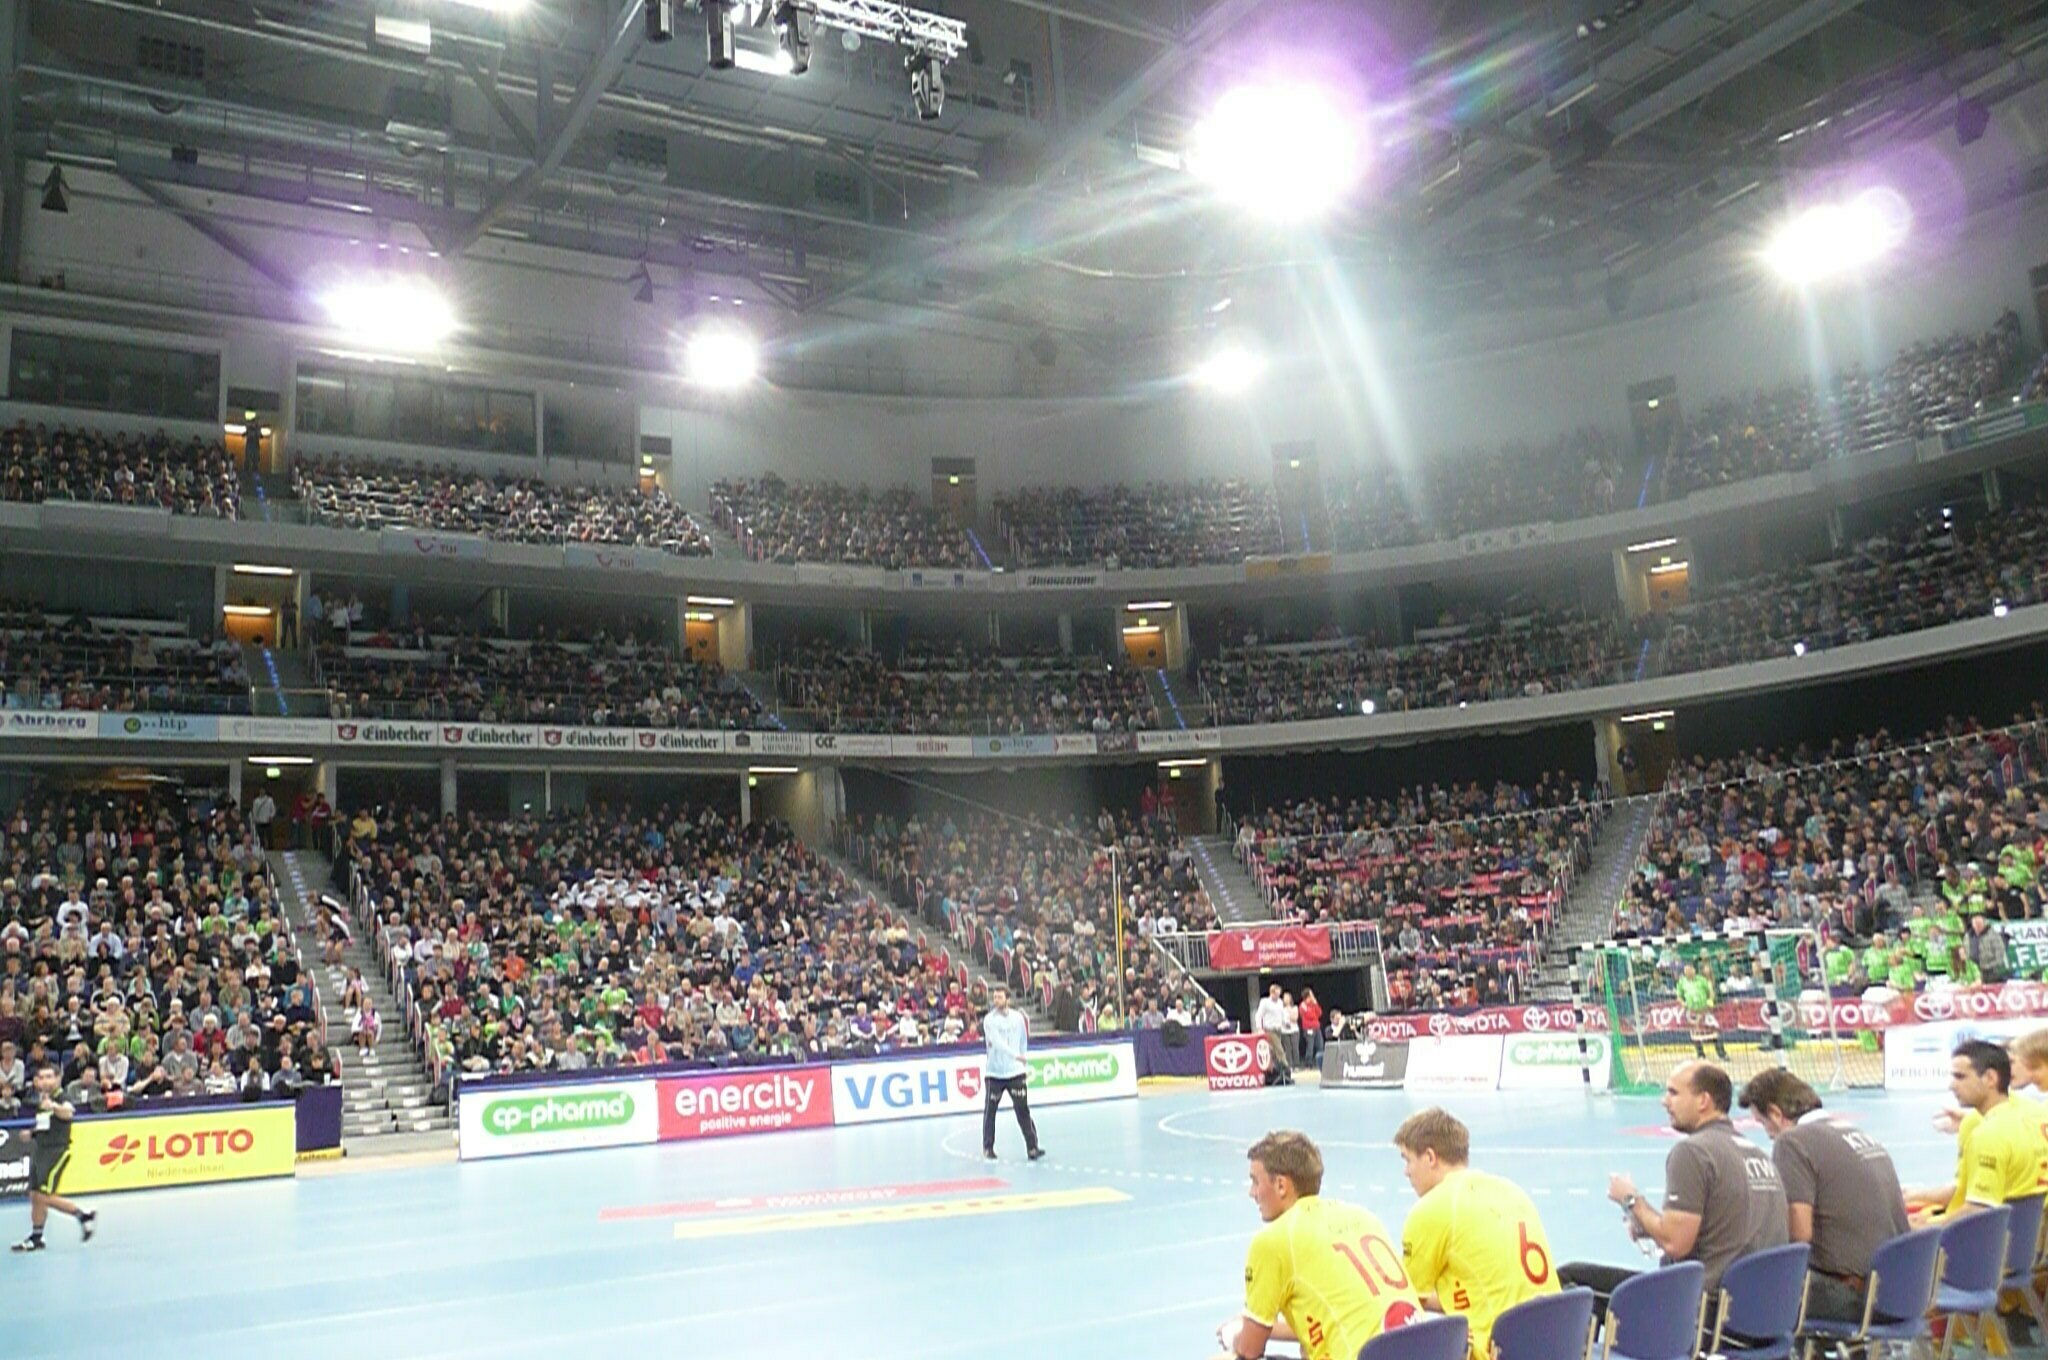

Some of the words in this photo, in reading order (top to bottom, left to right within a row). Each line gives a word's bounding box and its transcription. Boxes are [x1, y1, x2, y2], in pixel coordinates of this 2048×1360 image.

[1651, 1004, 1719, 1028] TOYOA
[1026, 1053, 1113, 1086] p-pharma
[1210, 1074, 1258, 1088] TOYOTA
[675, 1074, 814, 1117] enercity
[844, 1070, 948, 1110] VGH
[492, 1094, 627, 1130] cp-pharma
[700, 1115, 747, 1133] positive
[749, 1111, 792, 1127] energie
[148, 1128, 254, 1161] LOTTO
[147, 1163, 225, 1179] Niedersachsen
[1332, 1234, 1408, 1297] 10
[1518, 1221, 1549, 1285] 6
